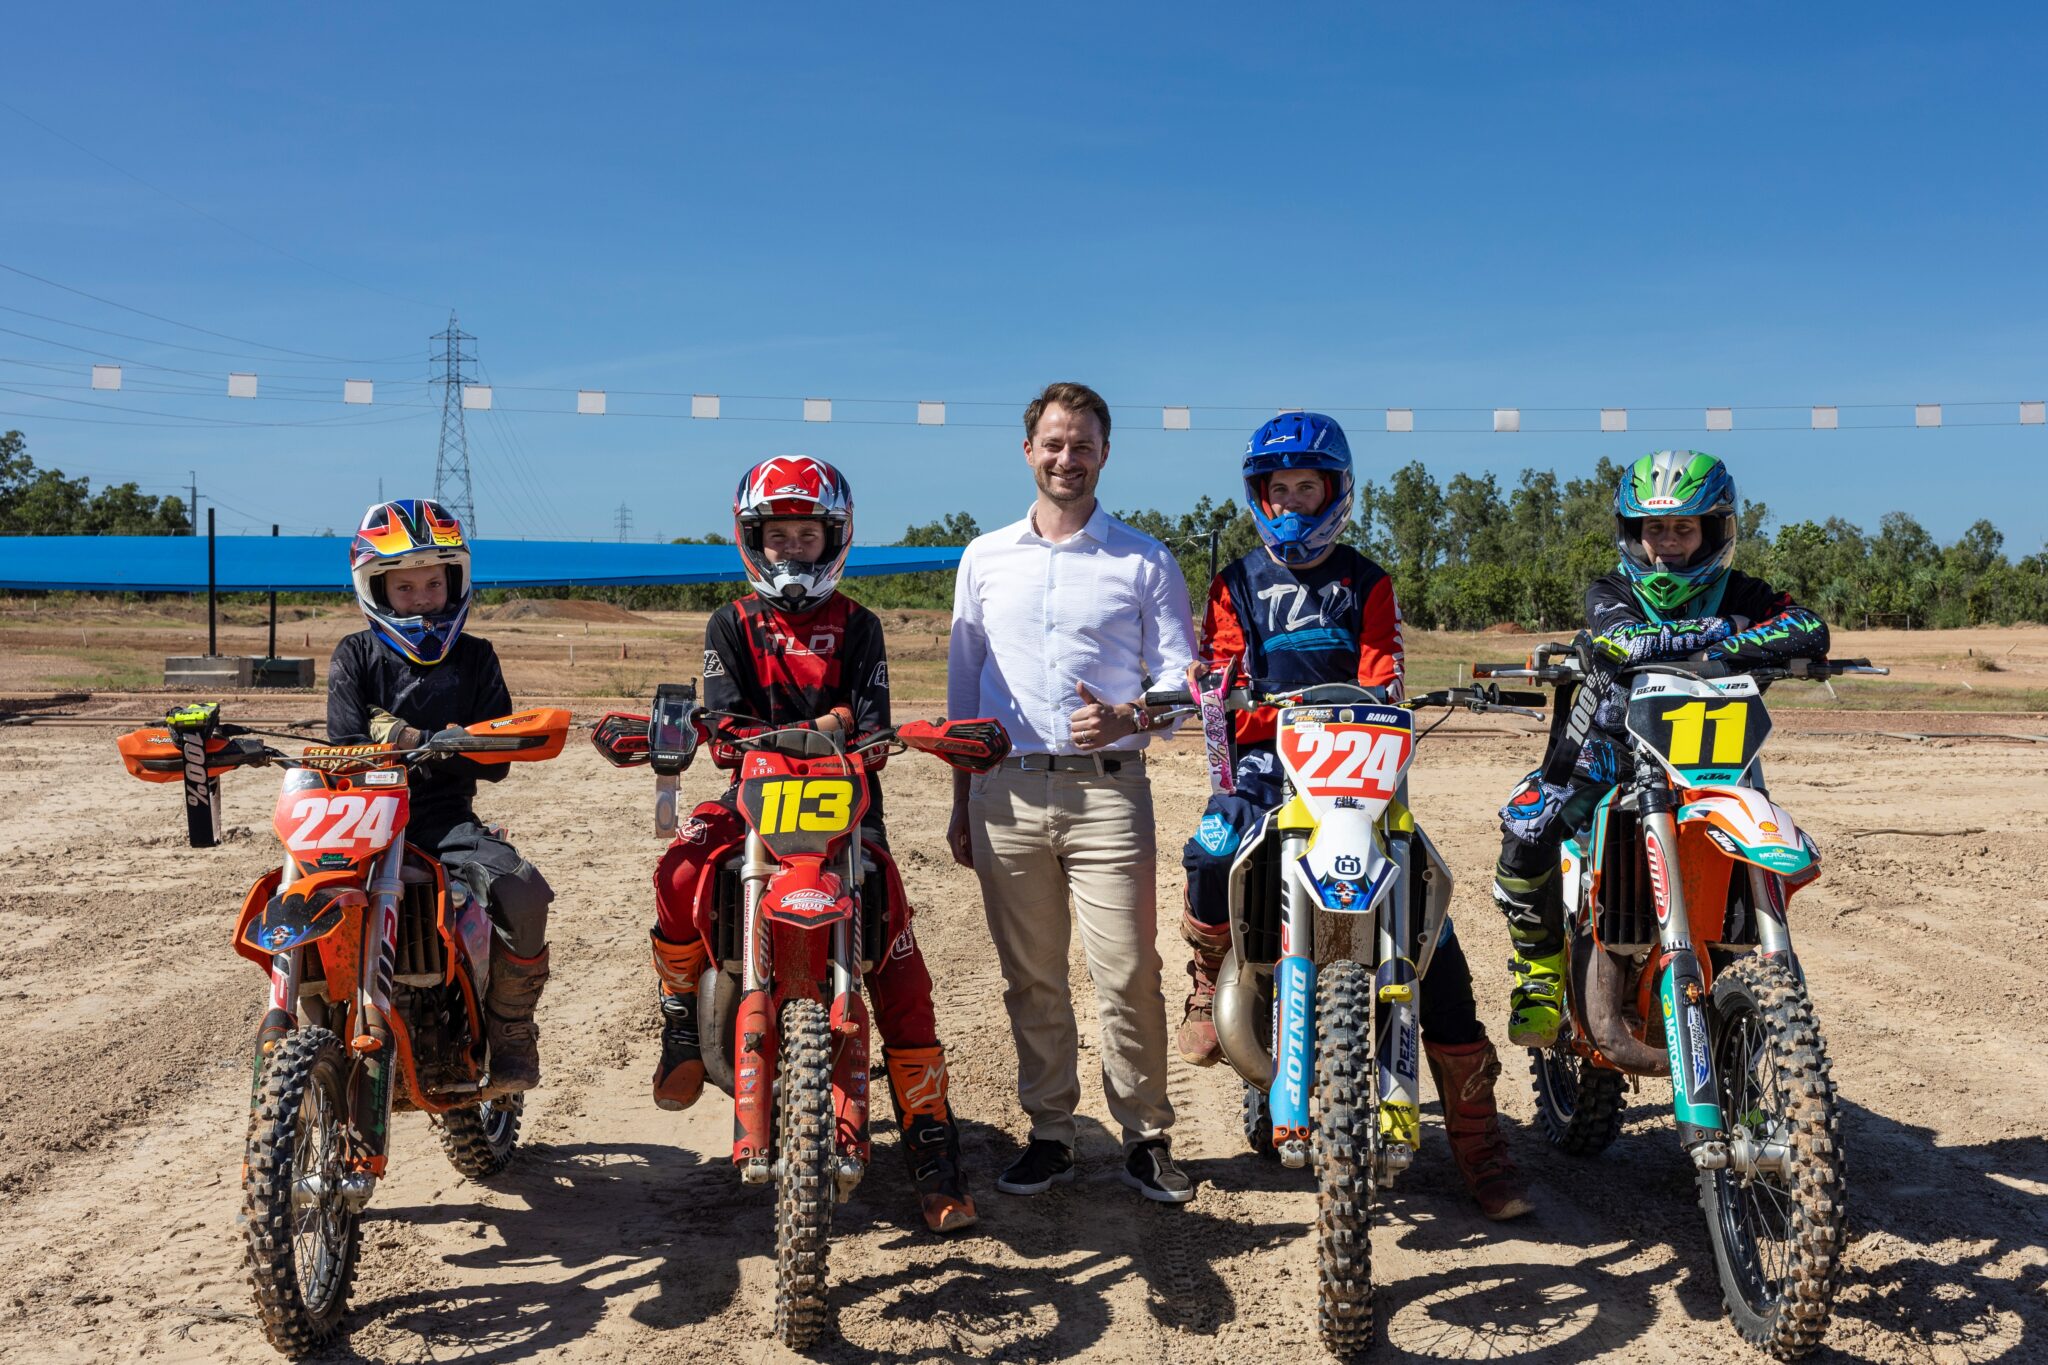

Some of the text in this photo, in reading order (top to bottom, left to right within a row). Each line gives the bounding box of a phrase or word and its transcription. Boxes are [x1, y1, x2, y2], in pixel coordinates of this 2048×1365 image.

[768, 633, 836, 656] TLD
[1366, 712, 1398, 724] BANJO
[1566, 664, 1611, 746] 100%
[1636, 685, 1667, 696] BEAU
[309, 746, 383, 757] RENTHAL
[1202, 694, 1229, 768] 100%
[1661, 701, 1748, 765] 11
[183, 731, 210, 807] 100%
[1296, 730, 1404, 793] 224
[1695, 772, 1732, 781] KTM
[286, 795, 400, 852] 224
[758, 780, 854, 836] 113
[1707, 830, 1737, 852] KTM
[1758, 852, 1800, 861] MOTOREX
[1271, 1001, 1279, 1061] MOTOREX
[1286, 965, 1307, 1106] DUNLOP
[1410, 1013, 1418, 1076] ELECTRICAL
[1664, 1017, 1684, 1096] MOTOREX
[1691, 1023, 1699, 1052] CENTRE
